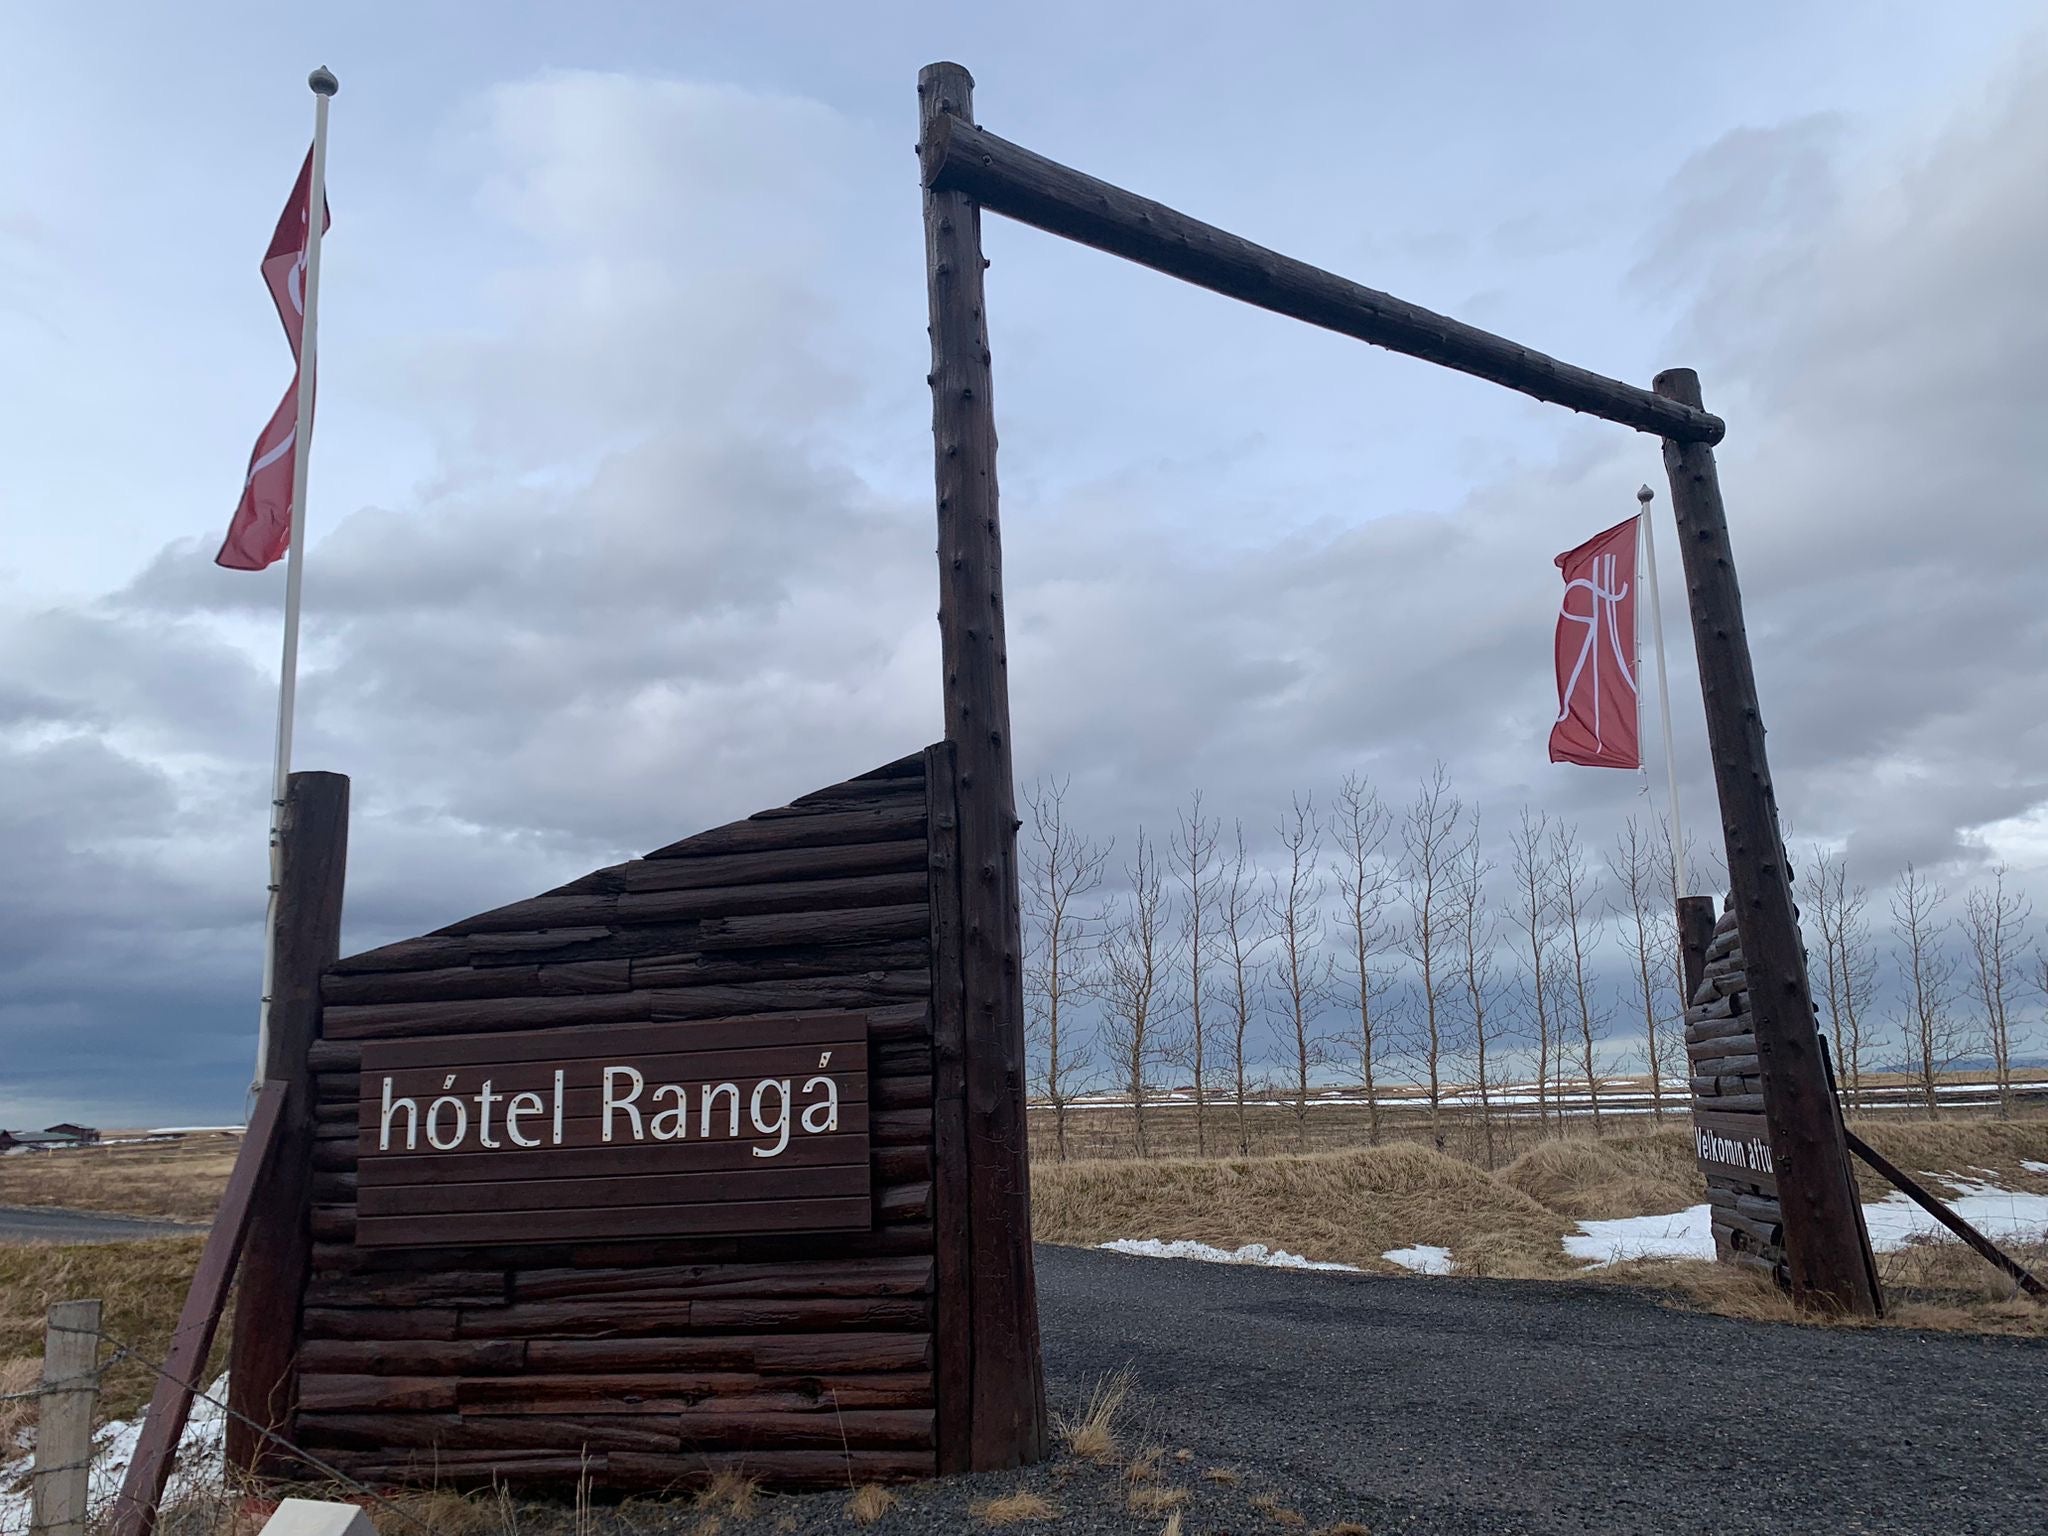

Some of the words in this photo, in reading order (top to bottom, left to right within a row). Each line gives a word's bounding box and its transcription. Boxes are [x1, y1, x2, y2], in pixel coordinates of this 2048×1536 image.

[379, 1069, 564, 1150] hótel
[602, 1051, 839, 1158] Rangá
[1694, 1126, 1747, 1168] Velkomin
[1747, 1137, 1774, 1174] aftu
